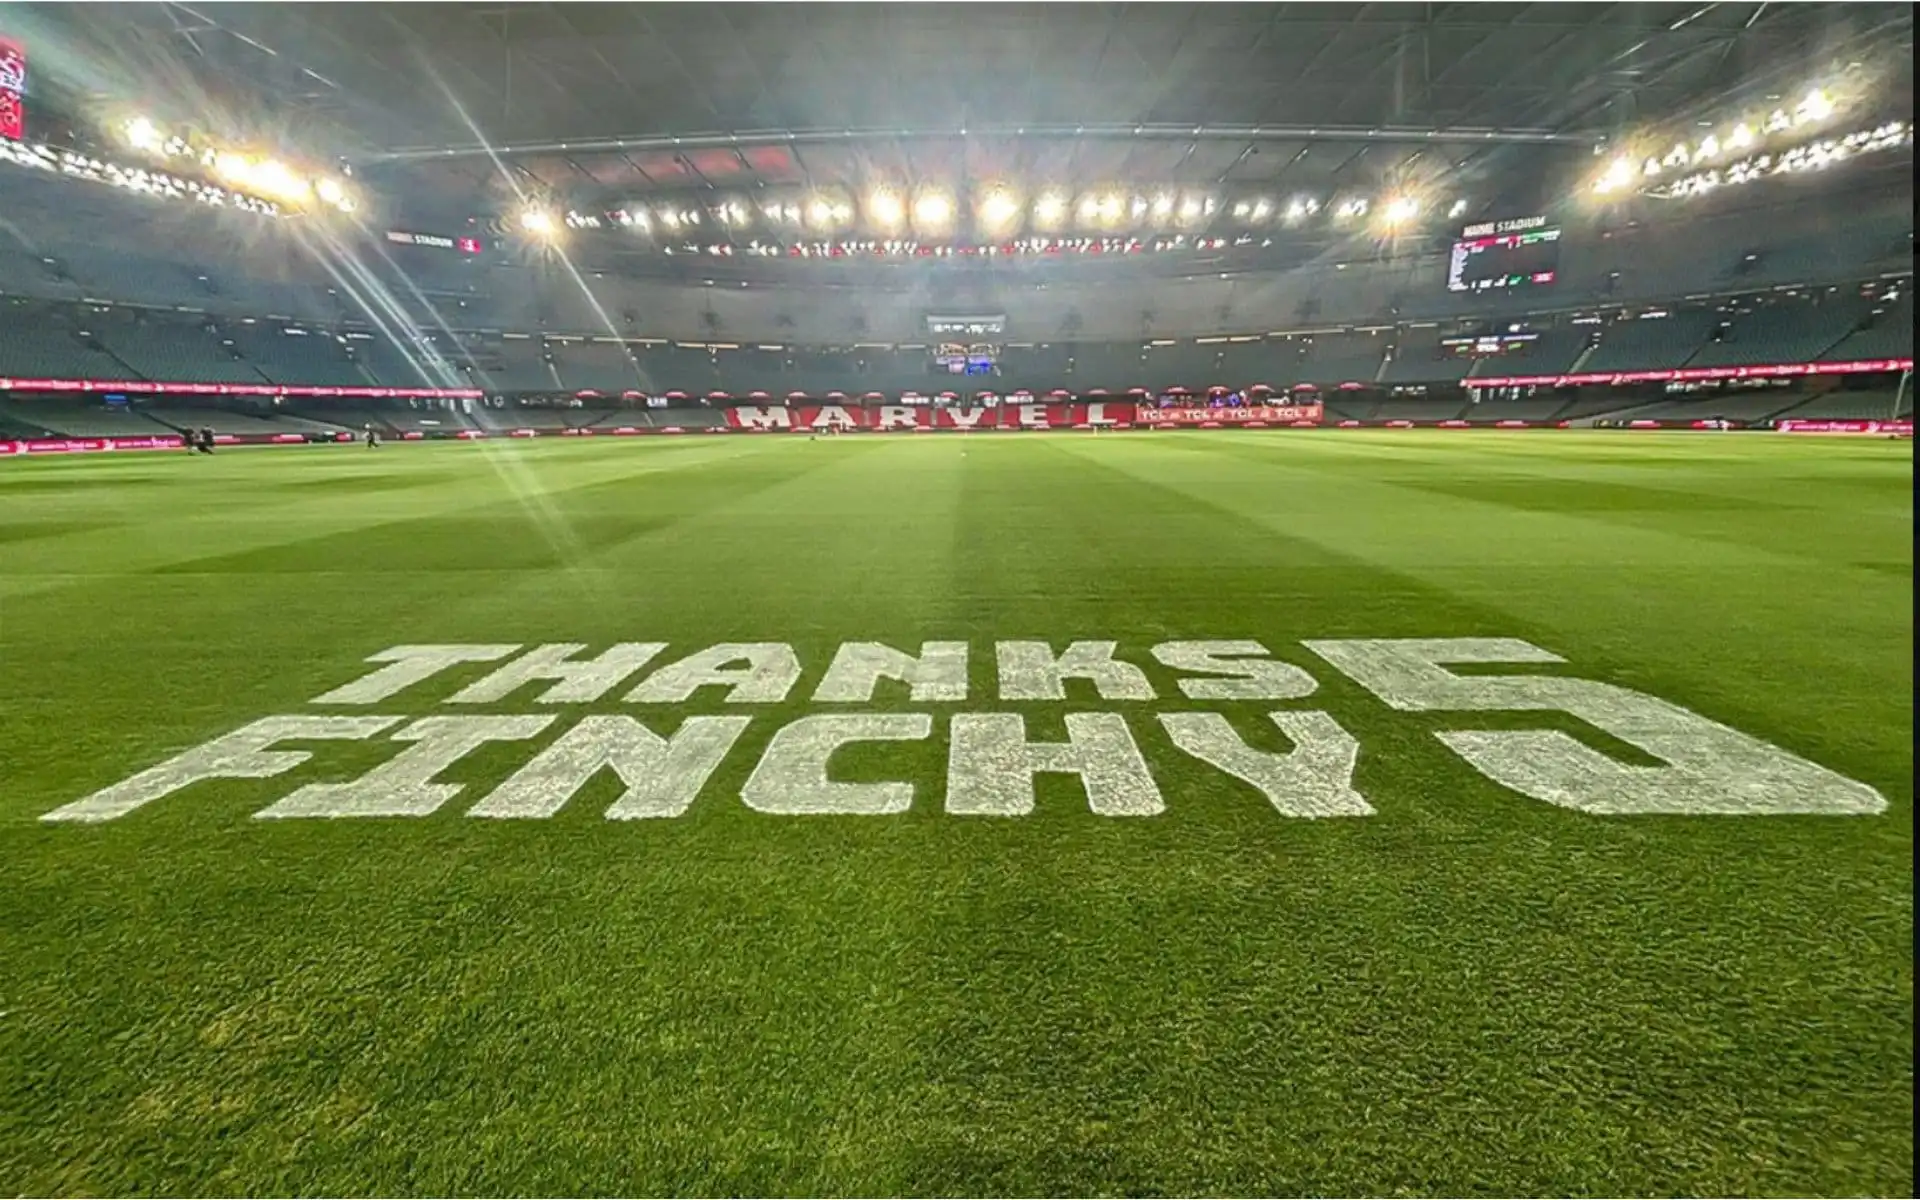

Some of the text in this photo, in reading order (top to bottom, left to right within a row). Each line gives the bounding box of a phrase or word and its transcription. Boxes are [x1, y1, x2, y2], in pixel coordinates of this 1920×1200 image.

[1497, 215, 1546, 232] STADIUM
[735, 403, 1117, 427] MARVEL
[1142, 409, 1165, 420] TCL
[1184, 409, 1210, 420] TCL
[1228, 408, 1253, 419] TCL
[309, 639, 1320, 703] THANKS
[1301, 637, 1890, 815] 5
[38, 710, 1377, 823] FINCHY
